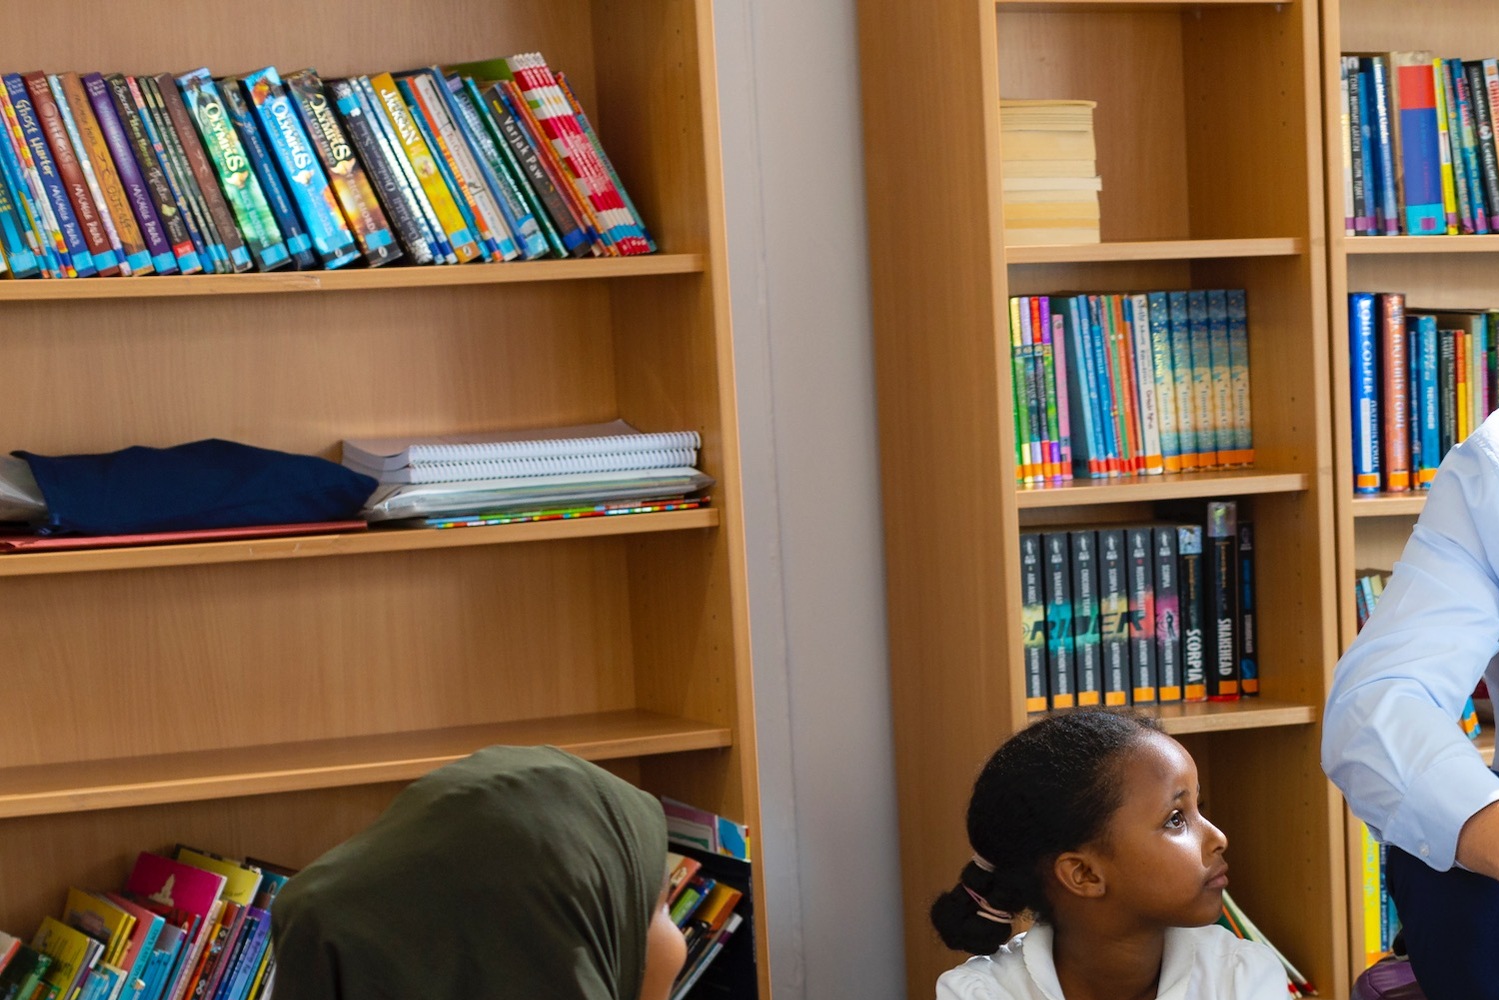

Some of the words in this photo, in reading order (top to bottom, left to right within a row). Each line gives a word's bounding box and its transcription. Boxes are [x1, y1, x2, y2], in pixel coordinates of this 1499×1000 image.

[307, 90, 352, 162] OLYMPUS
[379, 84, 420, 146] JACKSON
[1375, 84, 1386, 116] Midnight
[15, 97, 38, 134] Ghost
[29, 135, 56, 179] Hunter
[201, 100, 246, 172] OLYMPUS
[269, 97, 313, 170] OLYMPUS
[301, 99, 313, 116] THE
[309, 117, 323, 139] LOST
[319, 139, 336, 165] HERO
[500, 114, 531, 157] Varjak
[524, 154, 546, 181] Paw
[357, 201, 377, 234] RIORDA
[1361, 340, 1373, 393] COLFER
[1392, 333, 1404, 389] ARTEMIS
[1393, 394, 1405, 429] FOWL
[1425, 386, 1435, 429] REVENGE
[1371, 440, 1379, 469] FOWL
[1185, 629, 1203, 681] SCORPIA
[1217, 618, 1233, 675] SNAKEHEAD
